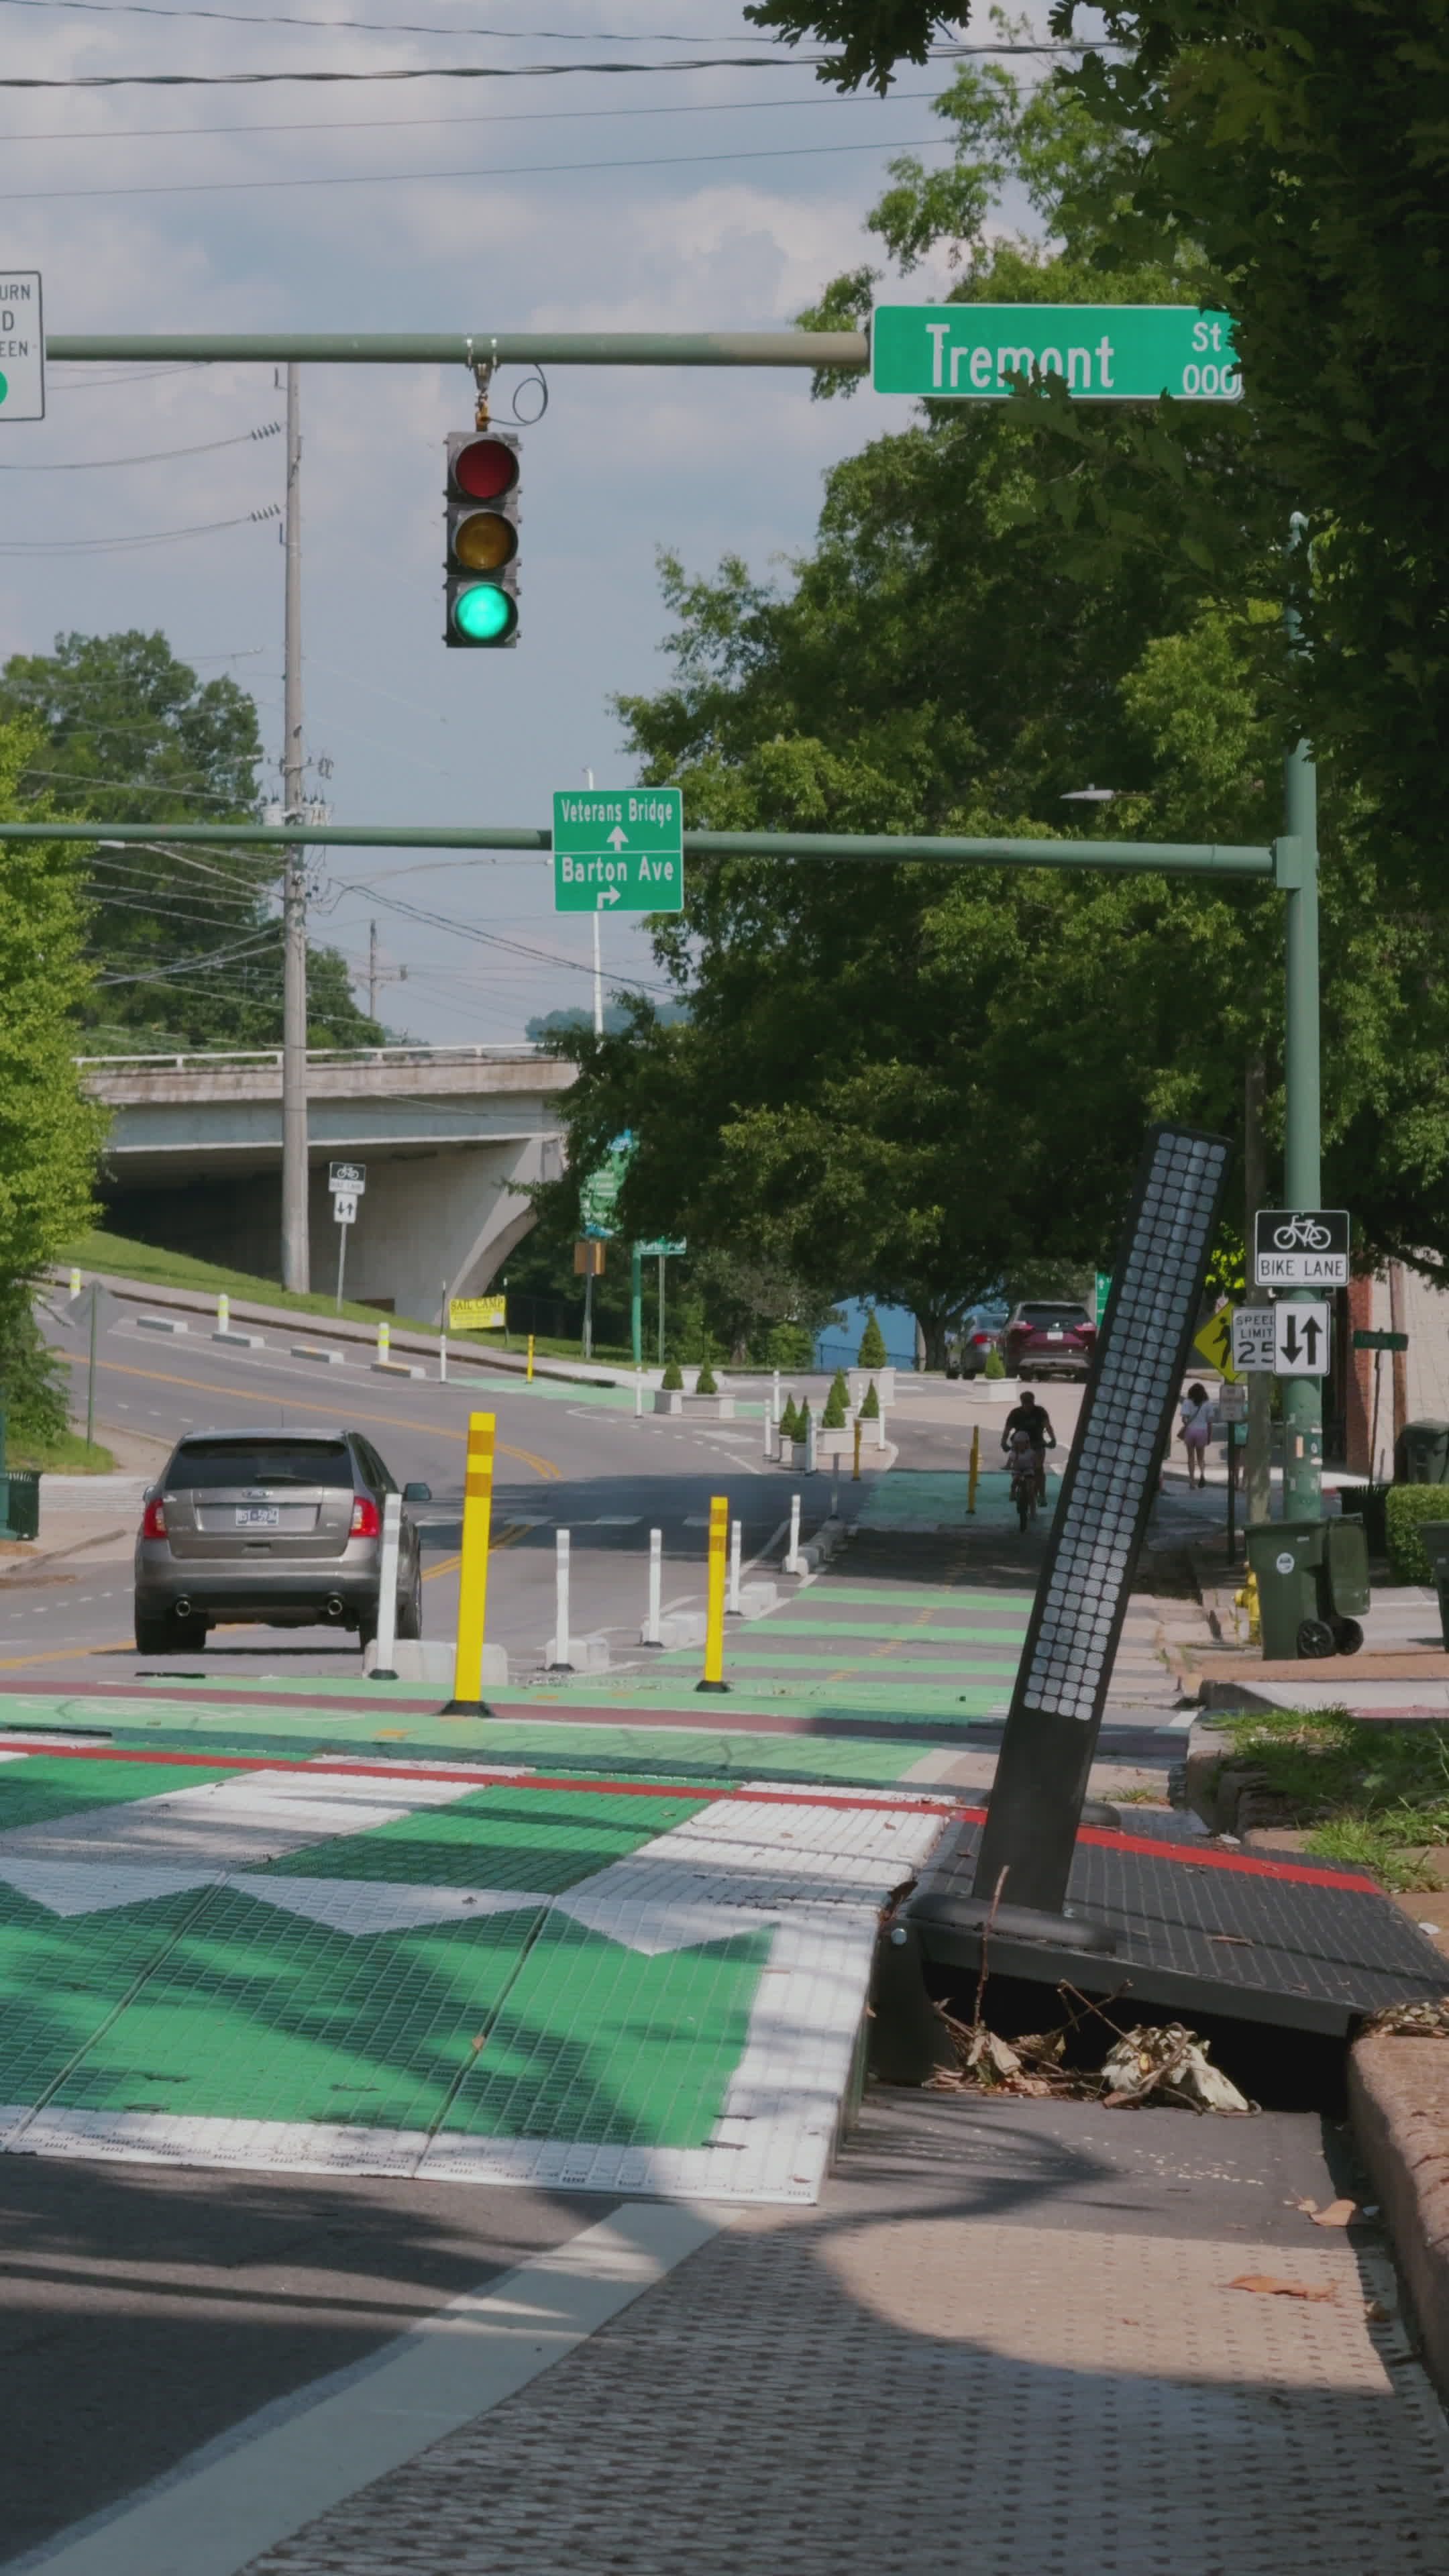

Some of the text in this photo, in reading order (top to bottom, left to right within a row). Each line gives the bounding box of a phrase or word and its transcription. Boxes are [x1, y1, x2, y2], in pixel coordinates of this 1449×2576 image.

[926, 321, 1222, 388] Tremont St
[1183, 364, 1237, 394] 000
[561, 798, 673, 828] Veterans Bridge
[561, 855, 674, 883] Barton Ave
[1260, 1260, 1344, 1276] BIKE LANE
[1241, 1329, 1273, 1339] LIMIT
[1238, 1342, 1274, 1364] 25
